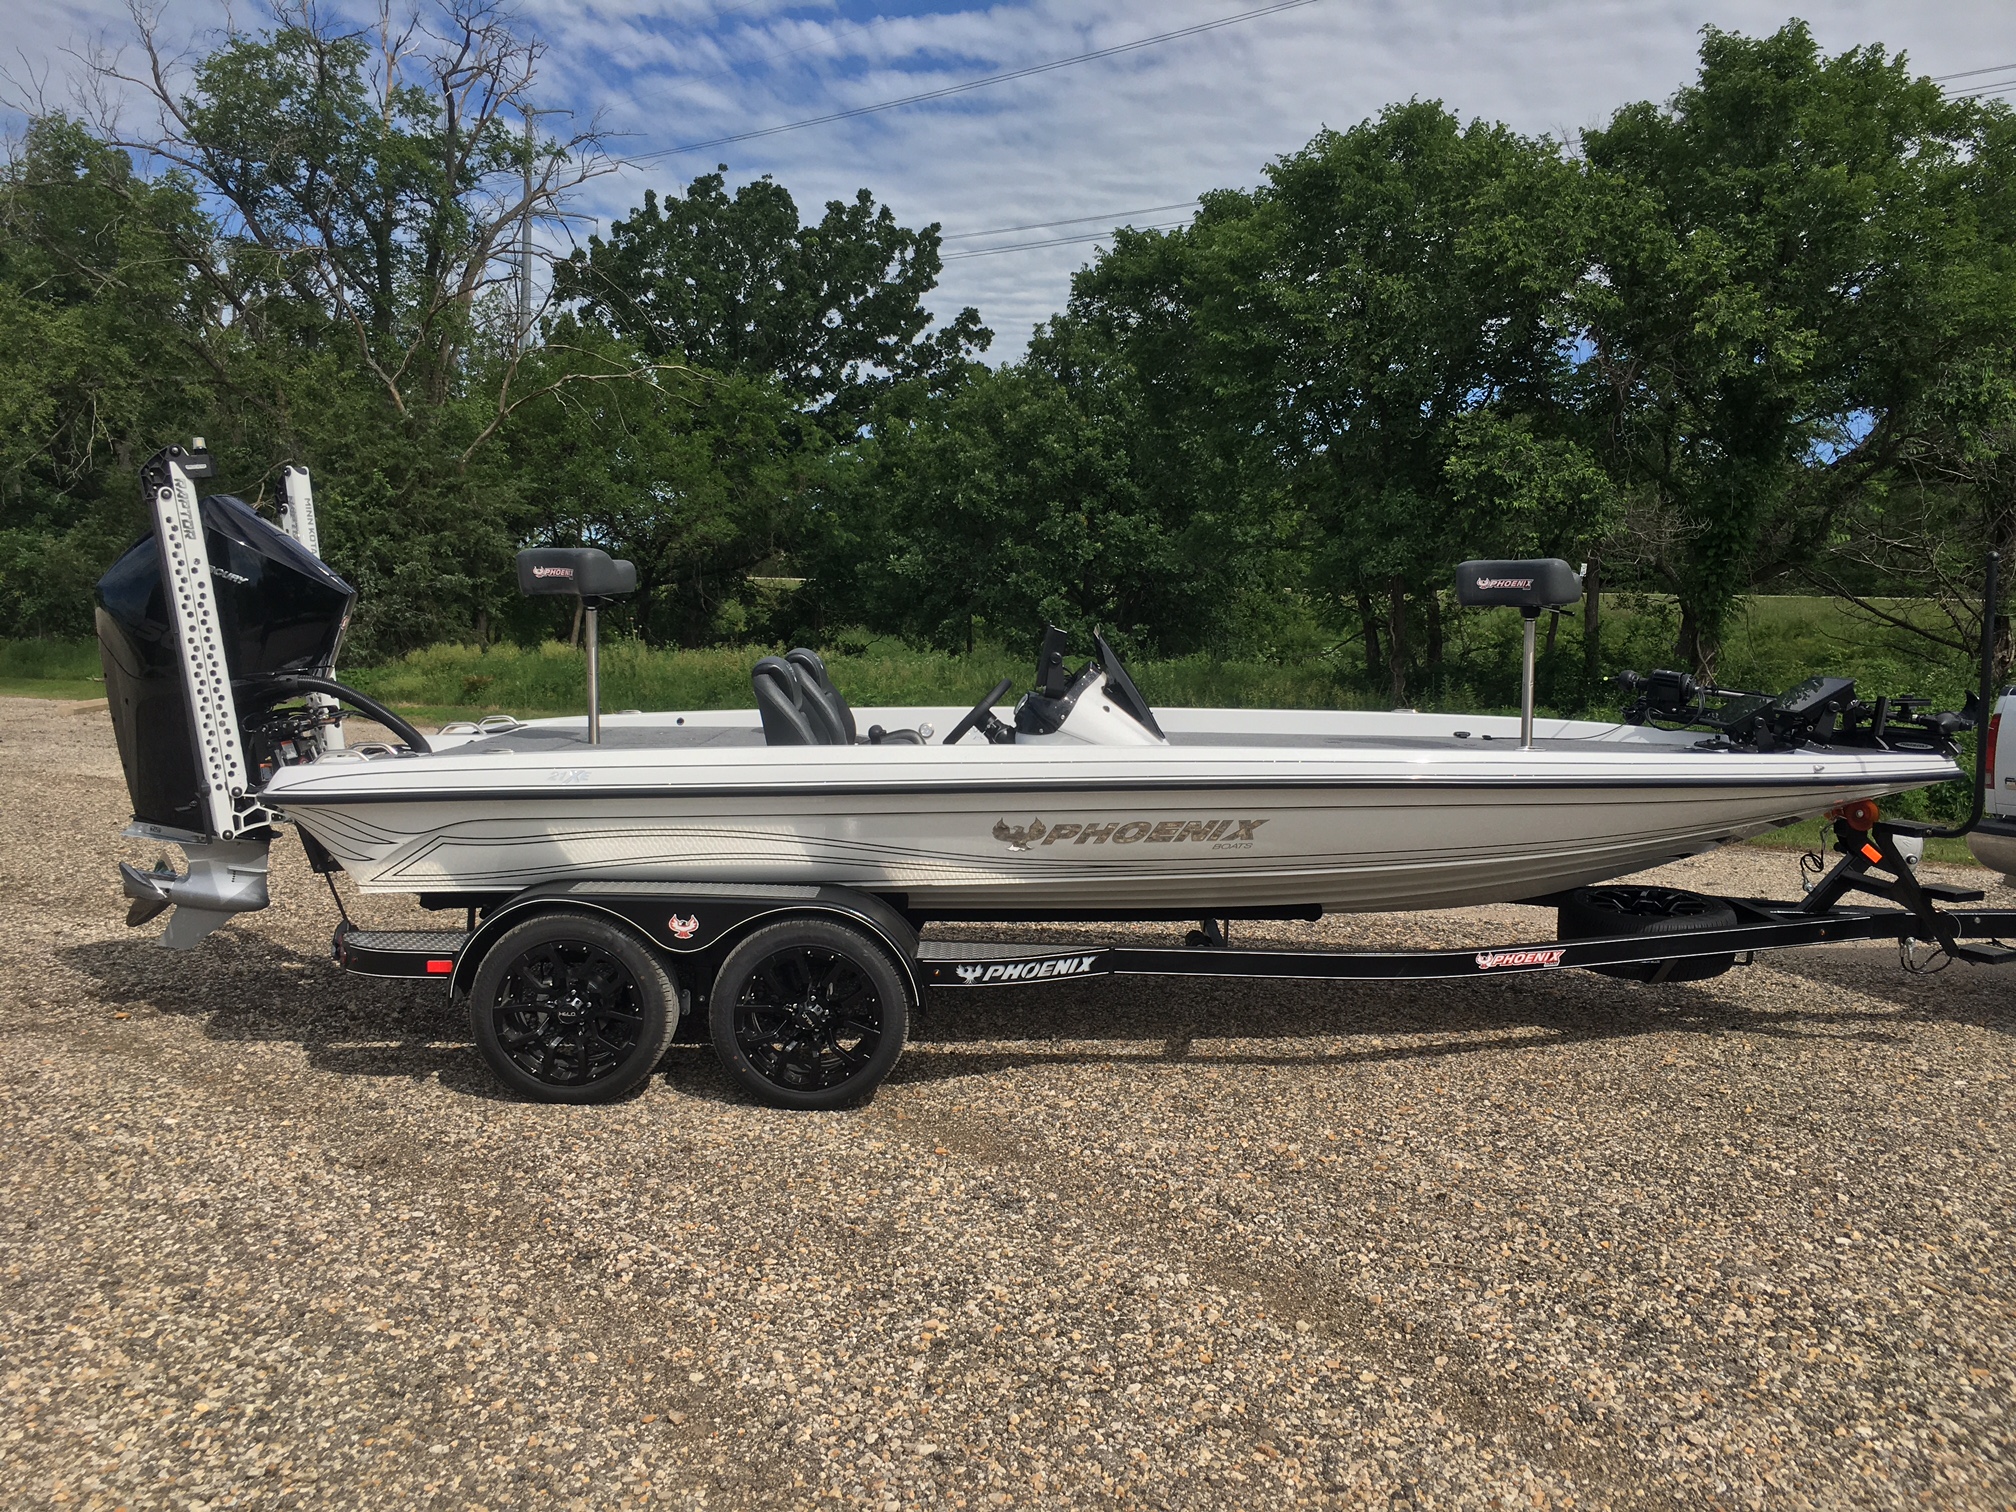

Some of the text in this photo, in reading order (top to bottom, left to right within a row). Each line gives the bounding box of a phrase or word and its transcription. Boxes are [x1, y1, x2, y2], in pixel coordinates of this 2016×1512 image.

[174, 478, 197, 540] RAPTOR
[304, 497, 318, 555] MINN KOTA
[1489, 579, 1532, 588] PHOENIX
[1040, 819, 1270, 845] PHOENIX
[1211, 842, 1253, 850] BOATS
[982, 955, 1099, 982] PHOENIX
[1492, 950, 1565, 966] PHOENIX
